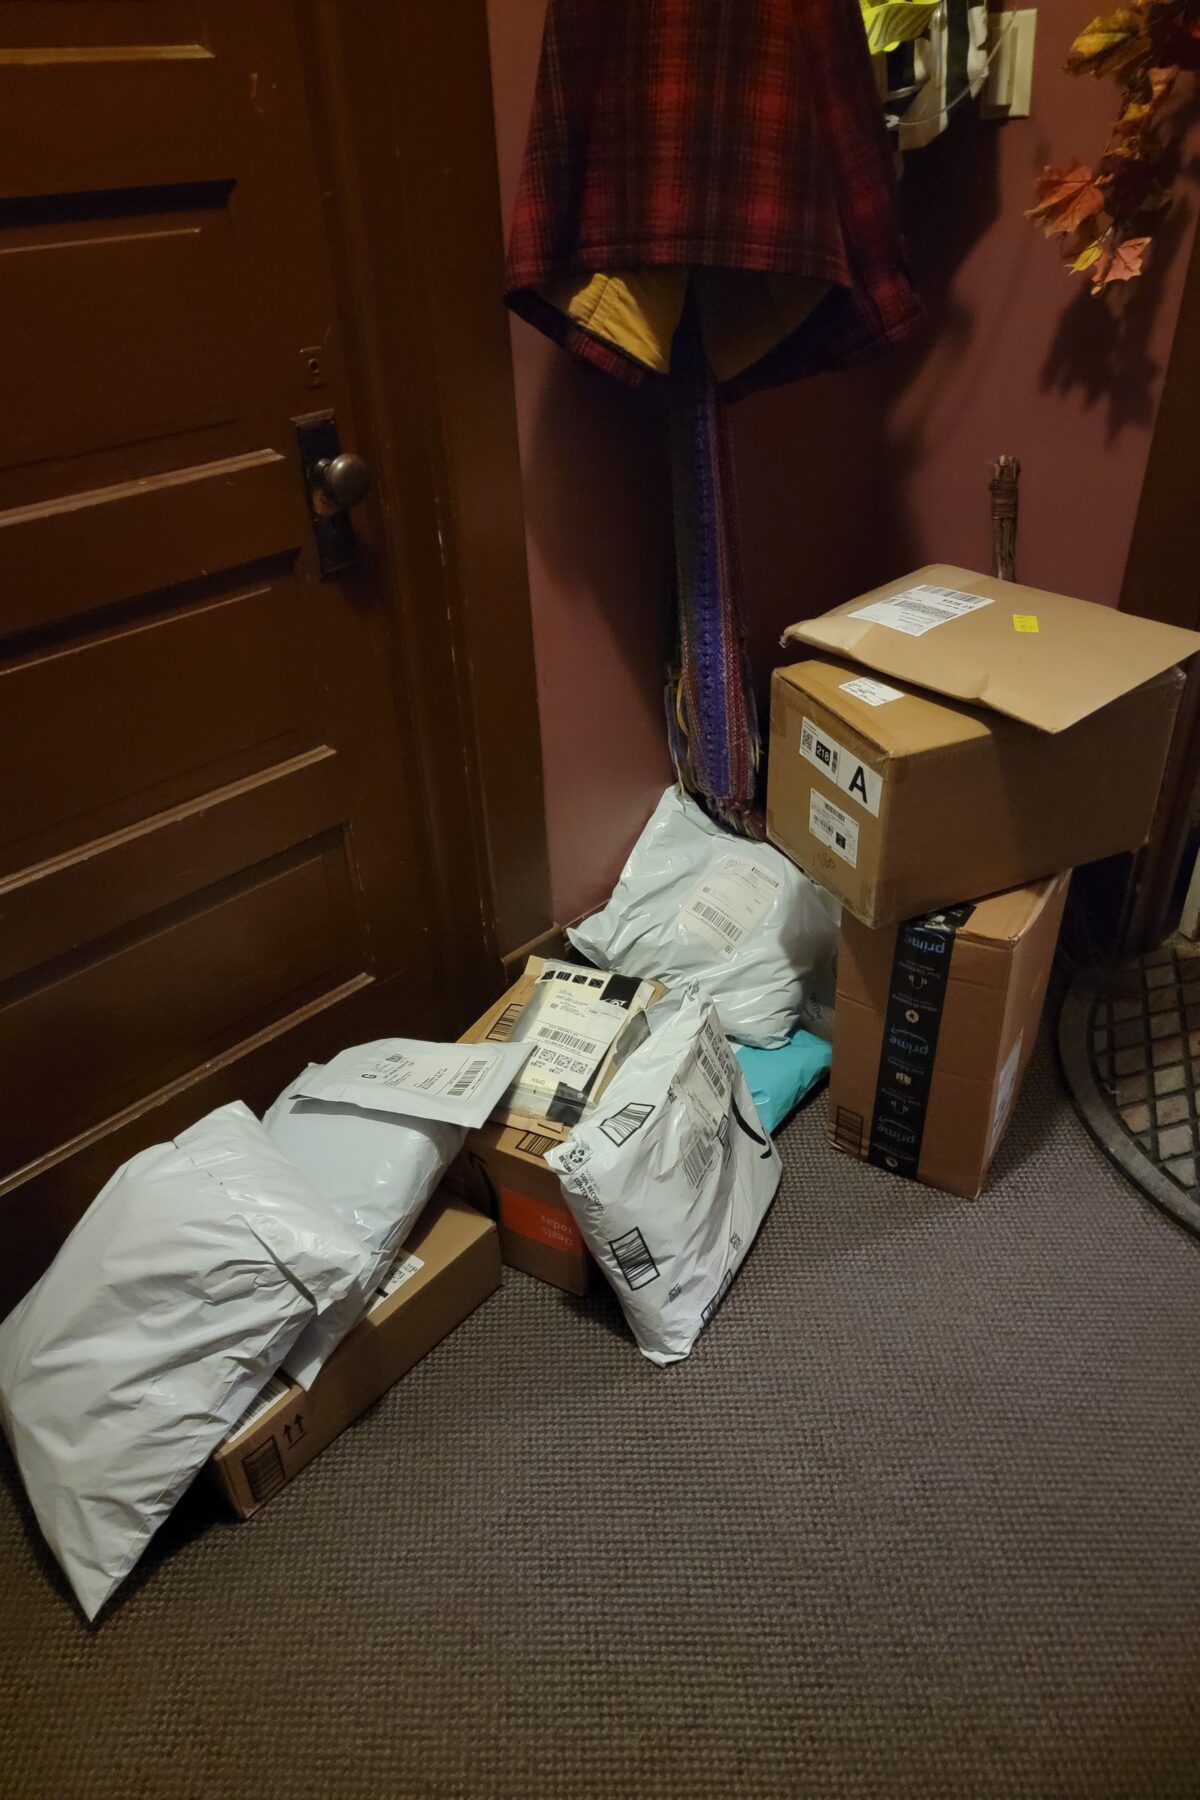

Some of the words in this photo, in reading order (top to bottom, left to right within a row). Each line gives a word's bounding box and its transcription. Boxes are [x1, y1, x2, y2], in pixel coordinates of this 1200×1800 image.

[848, 765, 867, 804] A
[904, 935, 945, 954] prime
[889, 1035, 929, 1055] prime
[878, 1123, 916, 1145] prime
